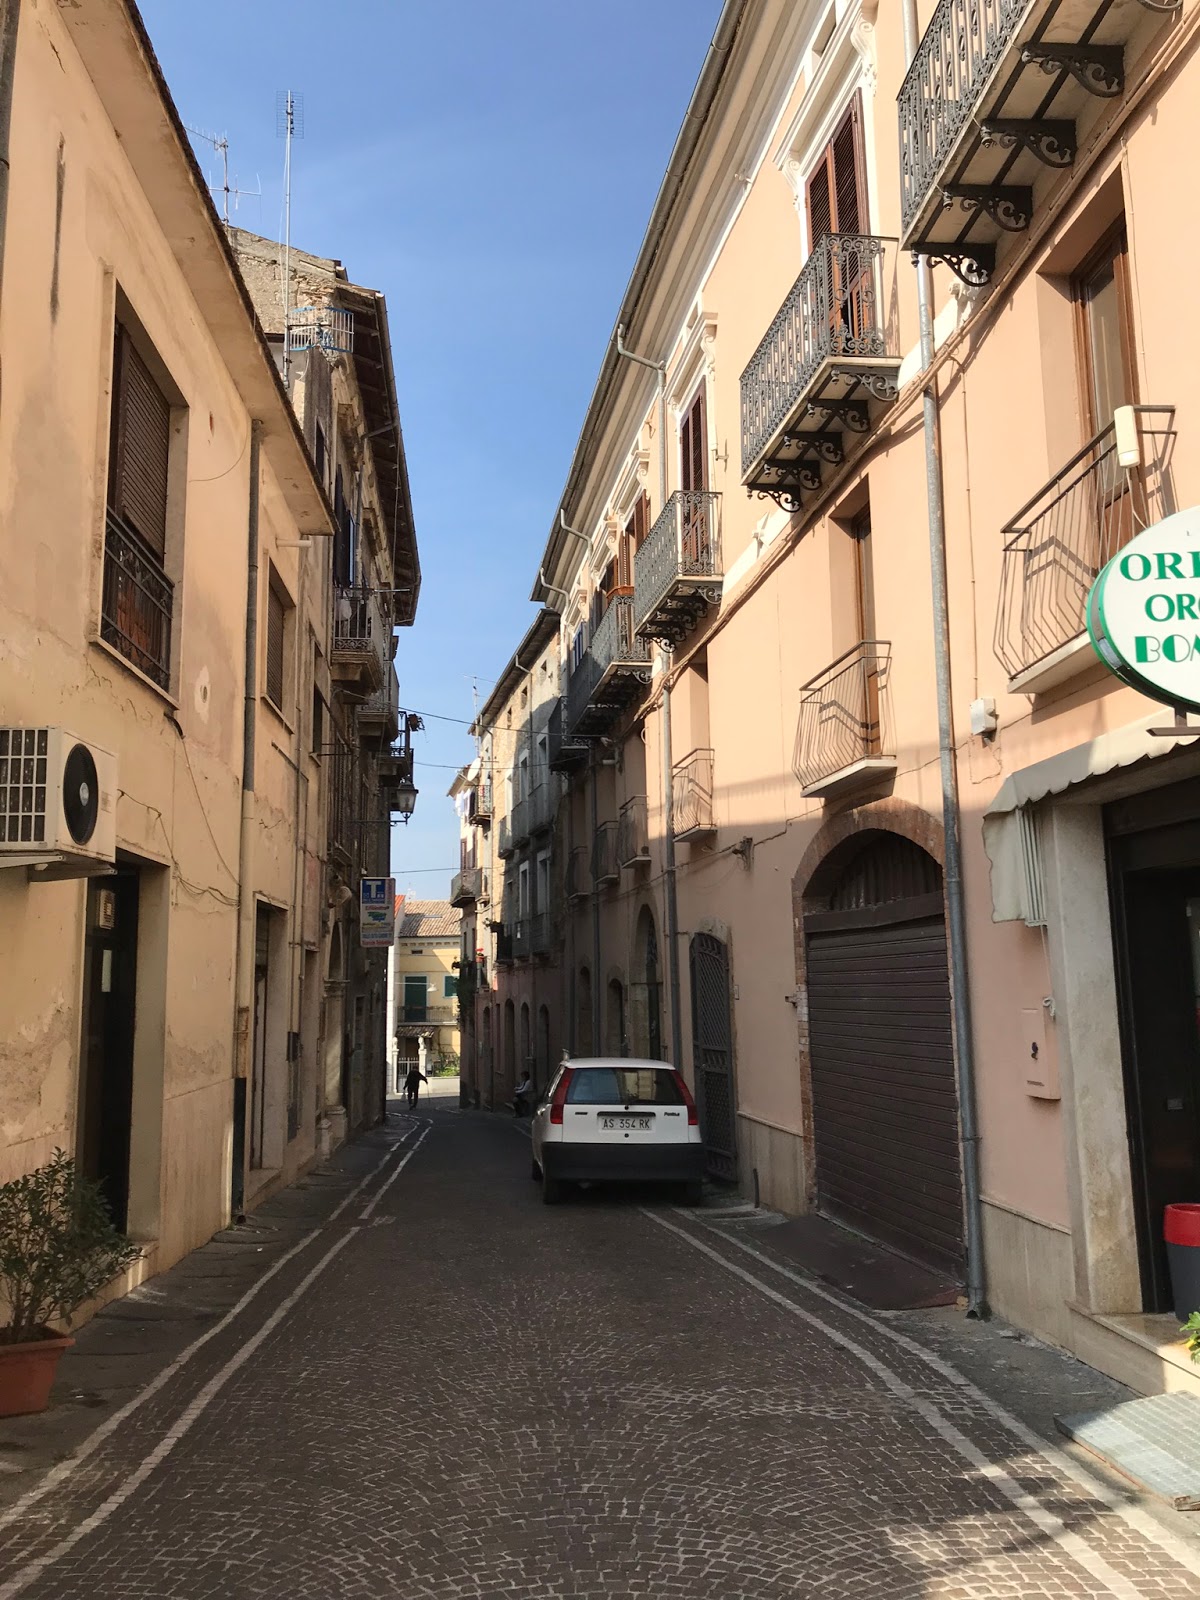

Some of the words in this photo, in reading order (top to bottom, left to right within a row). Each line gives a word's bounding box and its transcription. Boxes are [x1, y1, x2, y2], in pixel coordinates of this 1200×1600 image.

[1144, 593, 1200, 622] OR
[603, 1118, 614, 1129] AS
[619, 1118, 636, 1129] 354
[639, 1118, 650, 1129] RK
